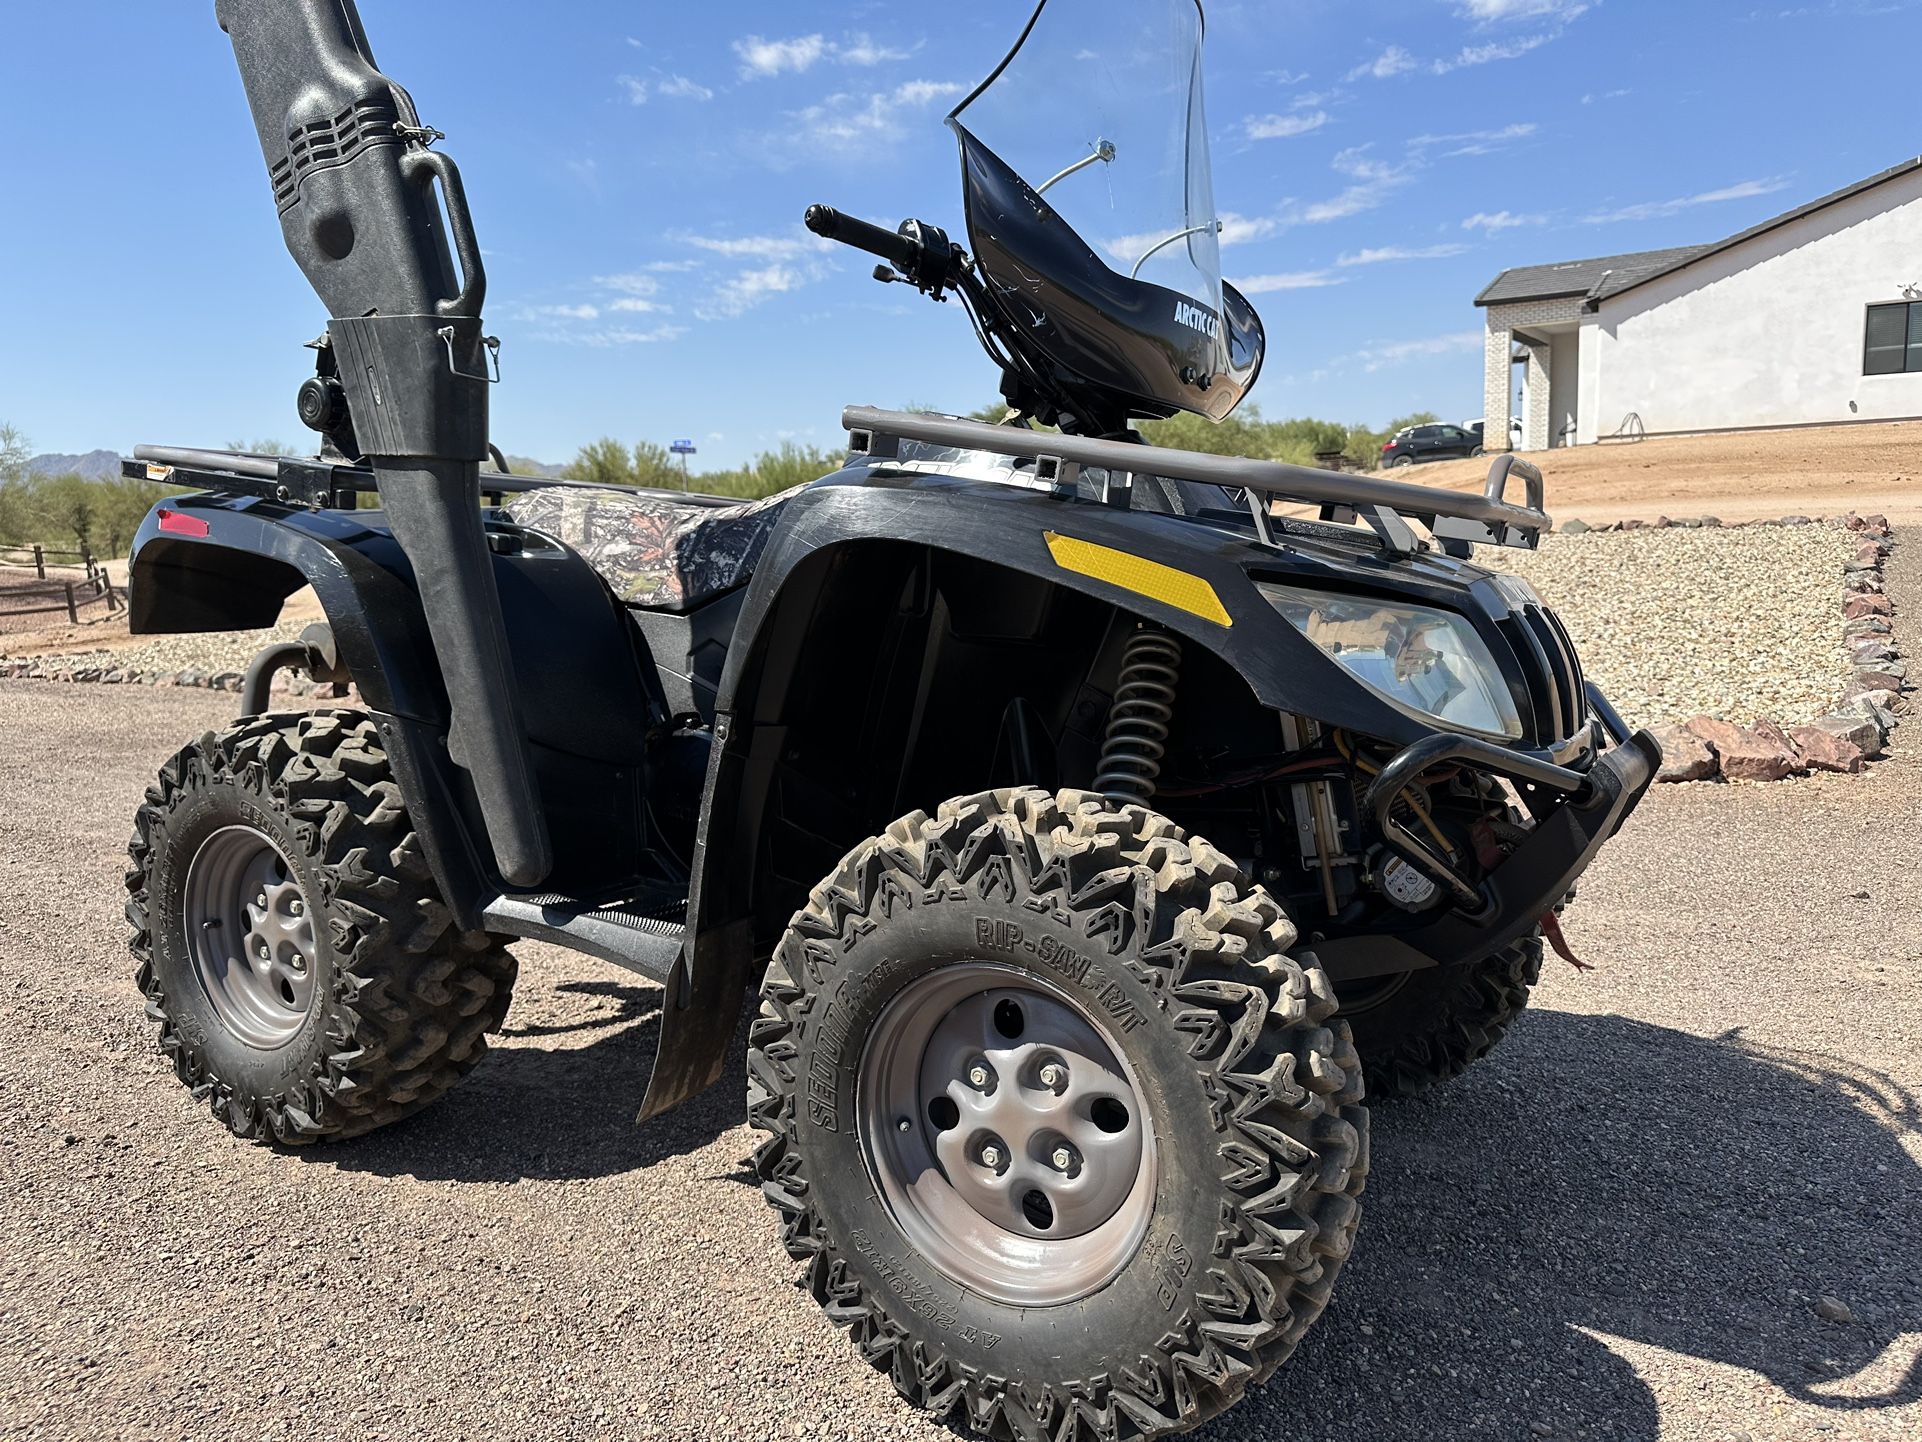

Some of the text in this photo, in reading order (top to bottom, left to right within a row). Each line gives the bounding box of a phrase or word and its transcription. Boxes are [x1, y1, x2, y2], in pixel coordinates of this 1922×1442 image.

[1174, 301, 1207, 334] ARCTIC
[975, 916, 1148, 1033] RIP-SAW R/T
[851, 1228, 1002, 1350] AT 26X9R12
